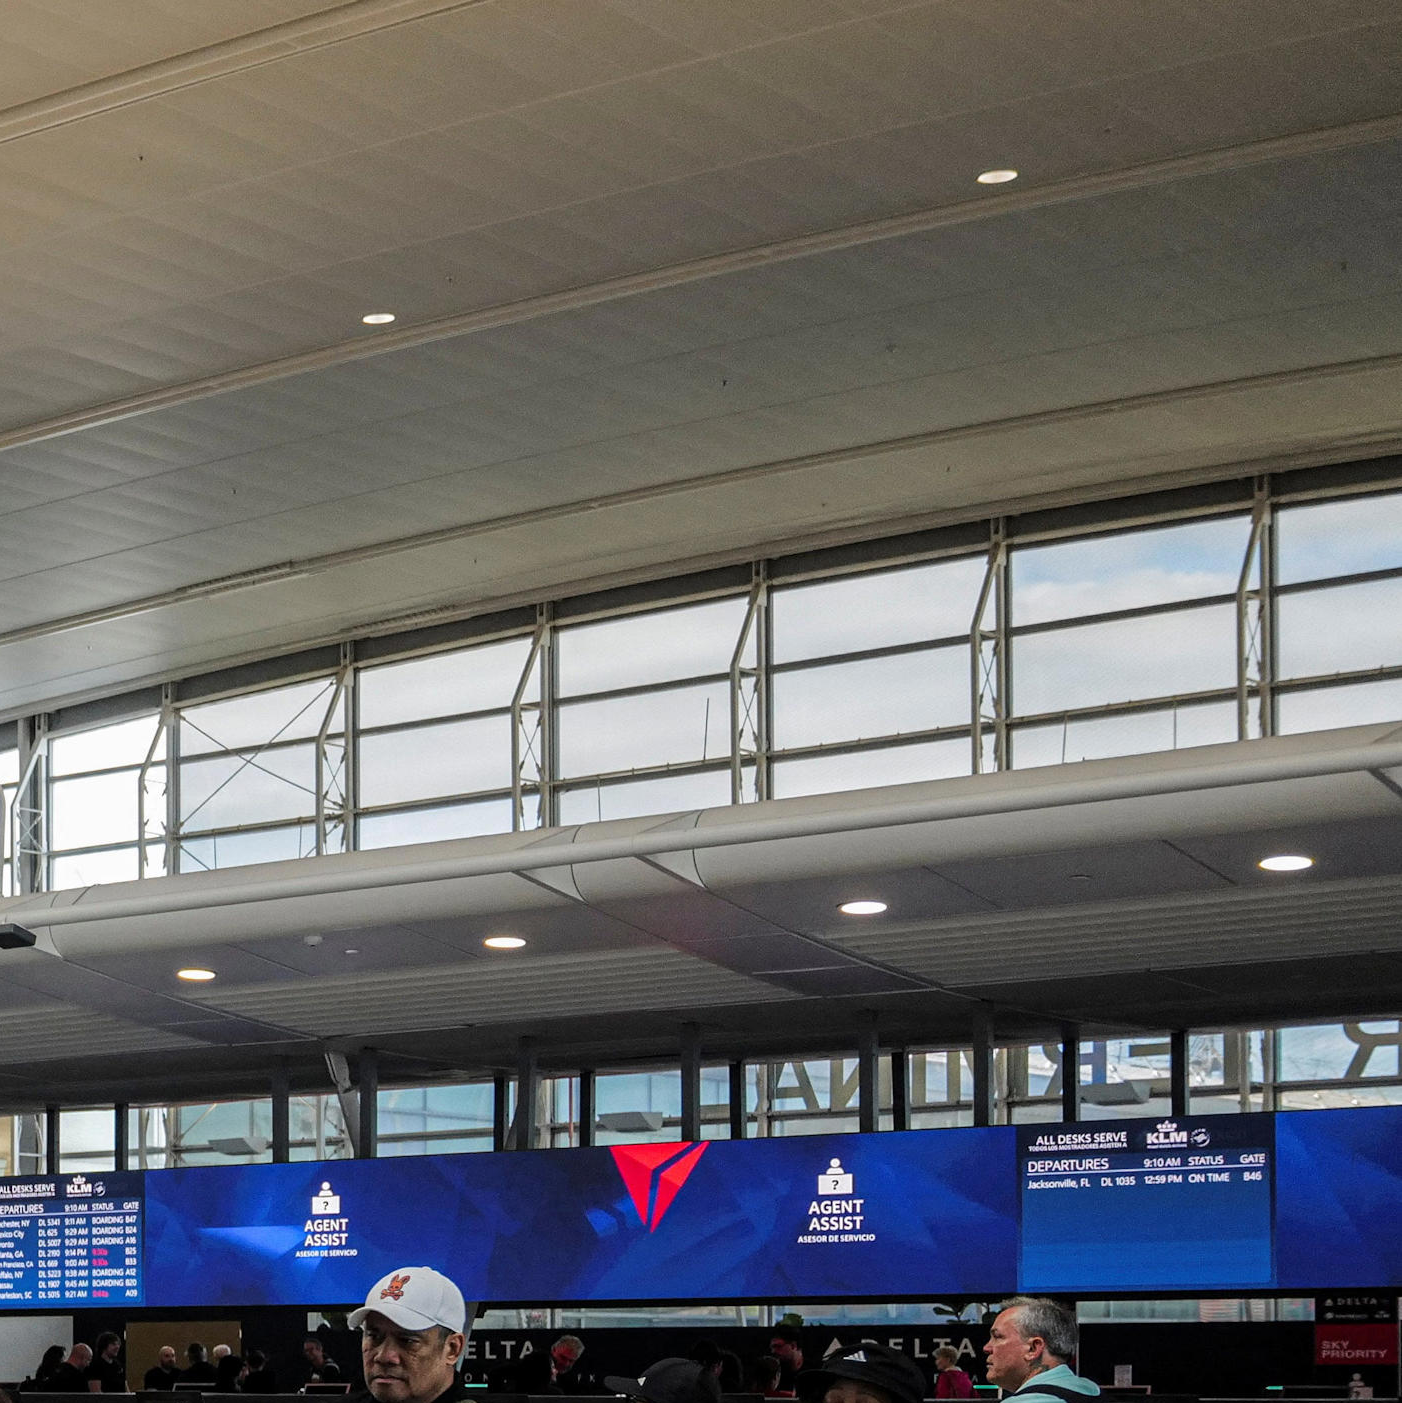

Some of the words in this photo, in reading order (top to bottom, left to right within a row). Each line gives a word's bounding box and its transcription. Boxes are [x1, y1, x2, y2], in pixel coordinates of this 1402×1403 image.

[1036, 1135, 1055, 1145] ALL
[1058, 1133, 1091, 1144] DESKS
[1093, 1132, 1127, 1143] SERVE
[1147, 1131, 1187, 1144] KLM
[1144, 1159, 1164, 1167] 9:10
[1165, 1158, 1181, 1166] AM
[1189, 1156, 1224, 1165] STATUS
[1240, 1154, 1265, 1163] GATE
[1028, 1158, 1108, 1173] DEPARTURES
[1028, 1179, 1078, 1190] Jacksonville,
[1081, 1178, 1090, 1187] FL
[1101, 1177, 1112, 1186] DL
[1116, 1177, 1135, 1186] 1035
[1145, 1175, 1166, 1184] 12:59
[1168, 1174, 1182, 1183] PM
[1189, 1173, 1205, 1183] ON
[1207, 1172, 1229, 1182] TIME
[34, 1184, 55, 1192] SERVE
[67, 1184, 92, 1193] KLM
[808, 1200, 864, 1214] AGENT
[304, 1219, 348, 1232] AGENT
[809, 1216, 864, 1231] ASSIST
[305, 1233, 348, 1246] ASSIST
[840, 1234, 875, 1242] SERVICIO
[465, 1341, 533, 1359] ELTA
[1322, 1341, 1349, 1349] SKY
[1322, 1349, 1387, 1358] PRIORITY
